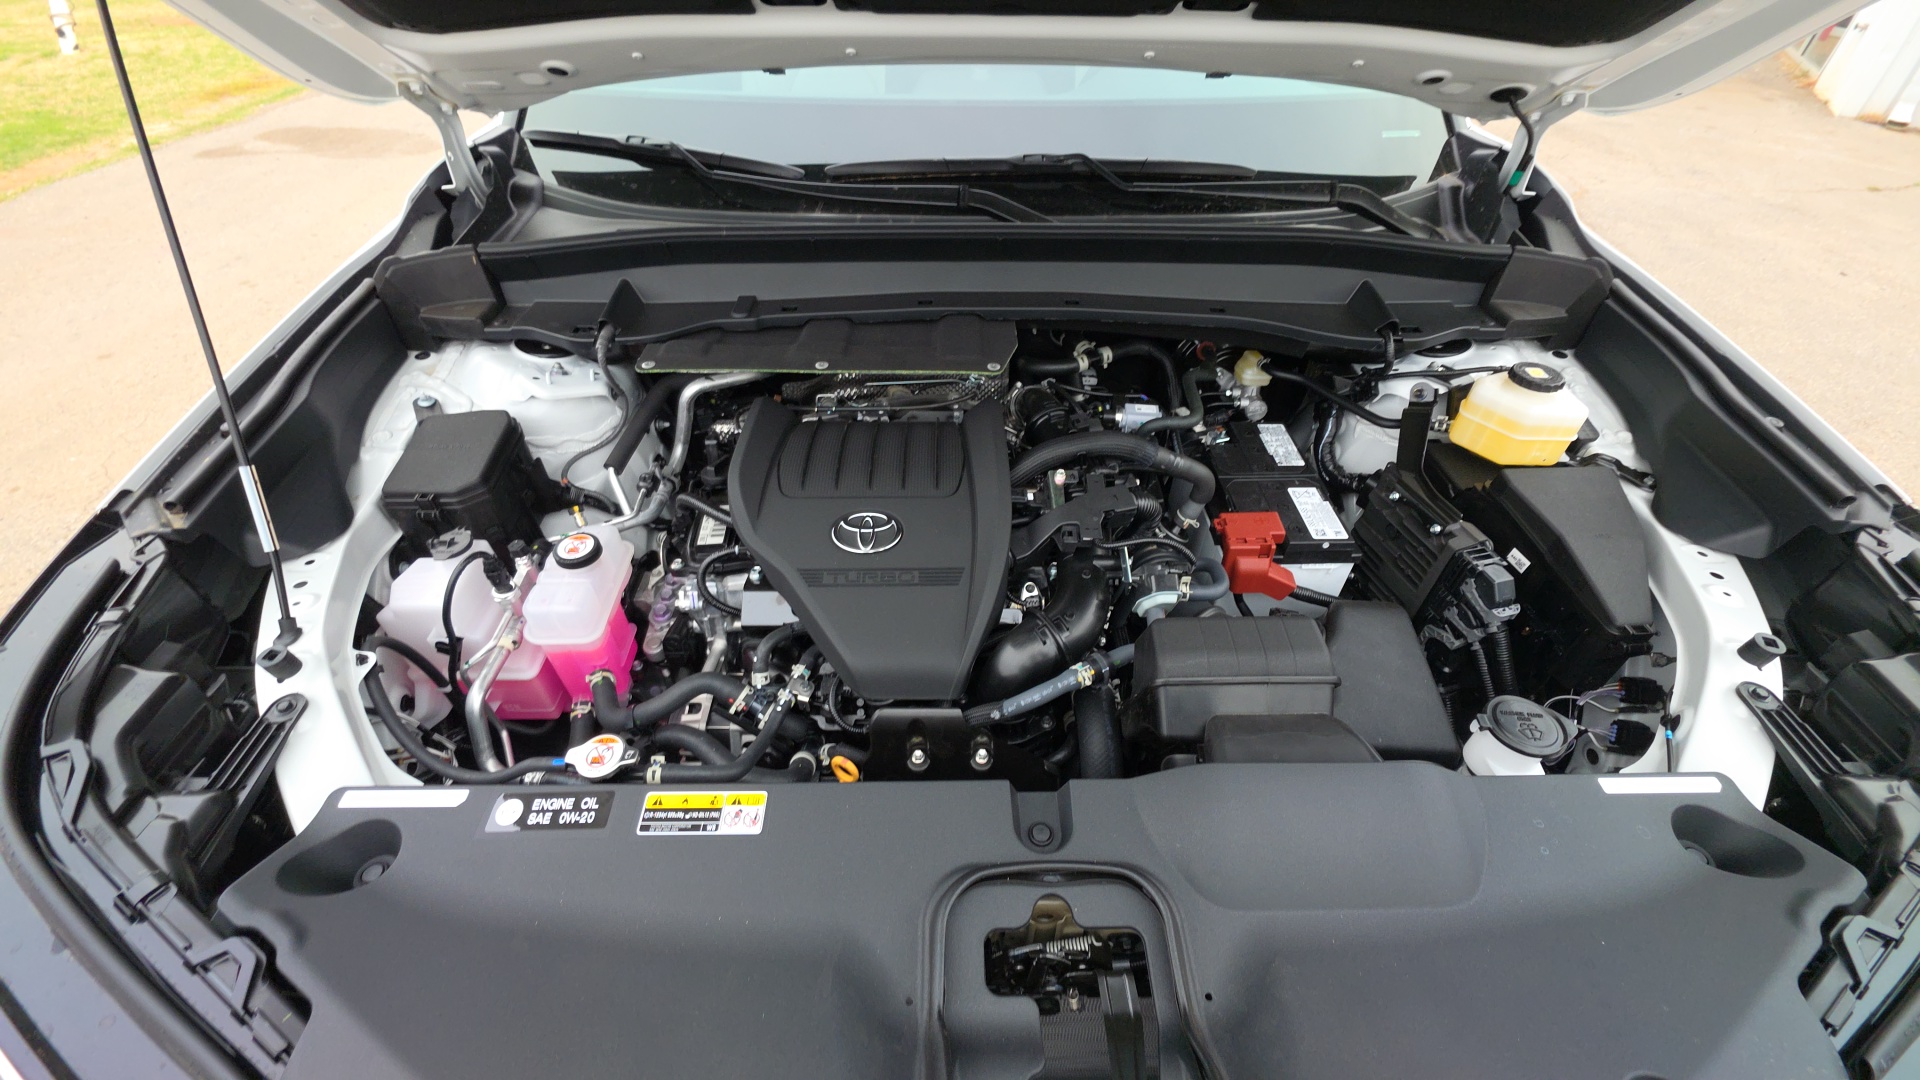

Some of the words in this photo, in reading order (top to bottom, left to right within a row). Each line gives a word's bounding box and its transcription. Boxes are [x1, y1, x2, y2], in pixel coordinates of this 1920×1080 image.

[824, 571, 916, 584] TURBO
[531, 797, 575, 811] ENGINE
[580, 796, 599, 810] OIL
[527, 811, 553, 825] SAE
[558, 811, 596, 825] 0W-20
